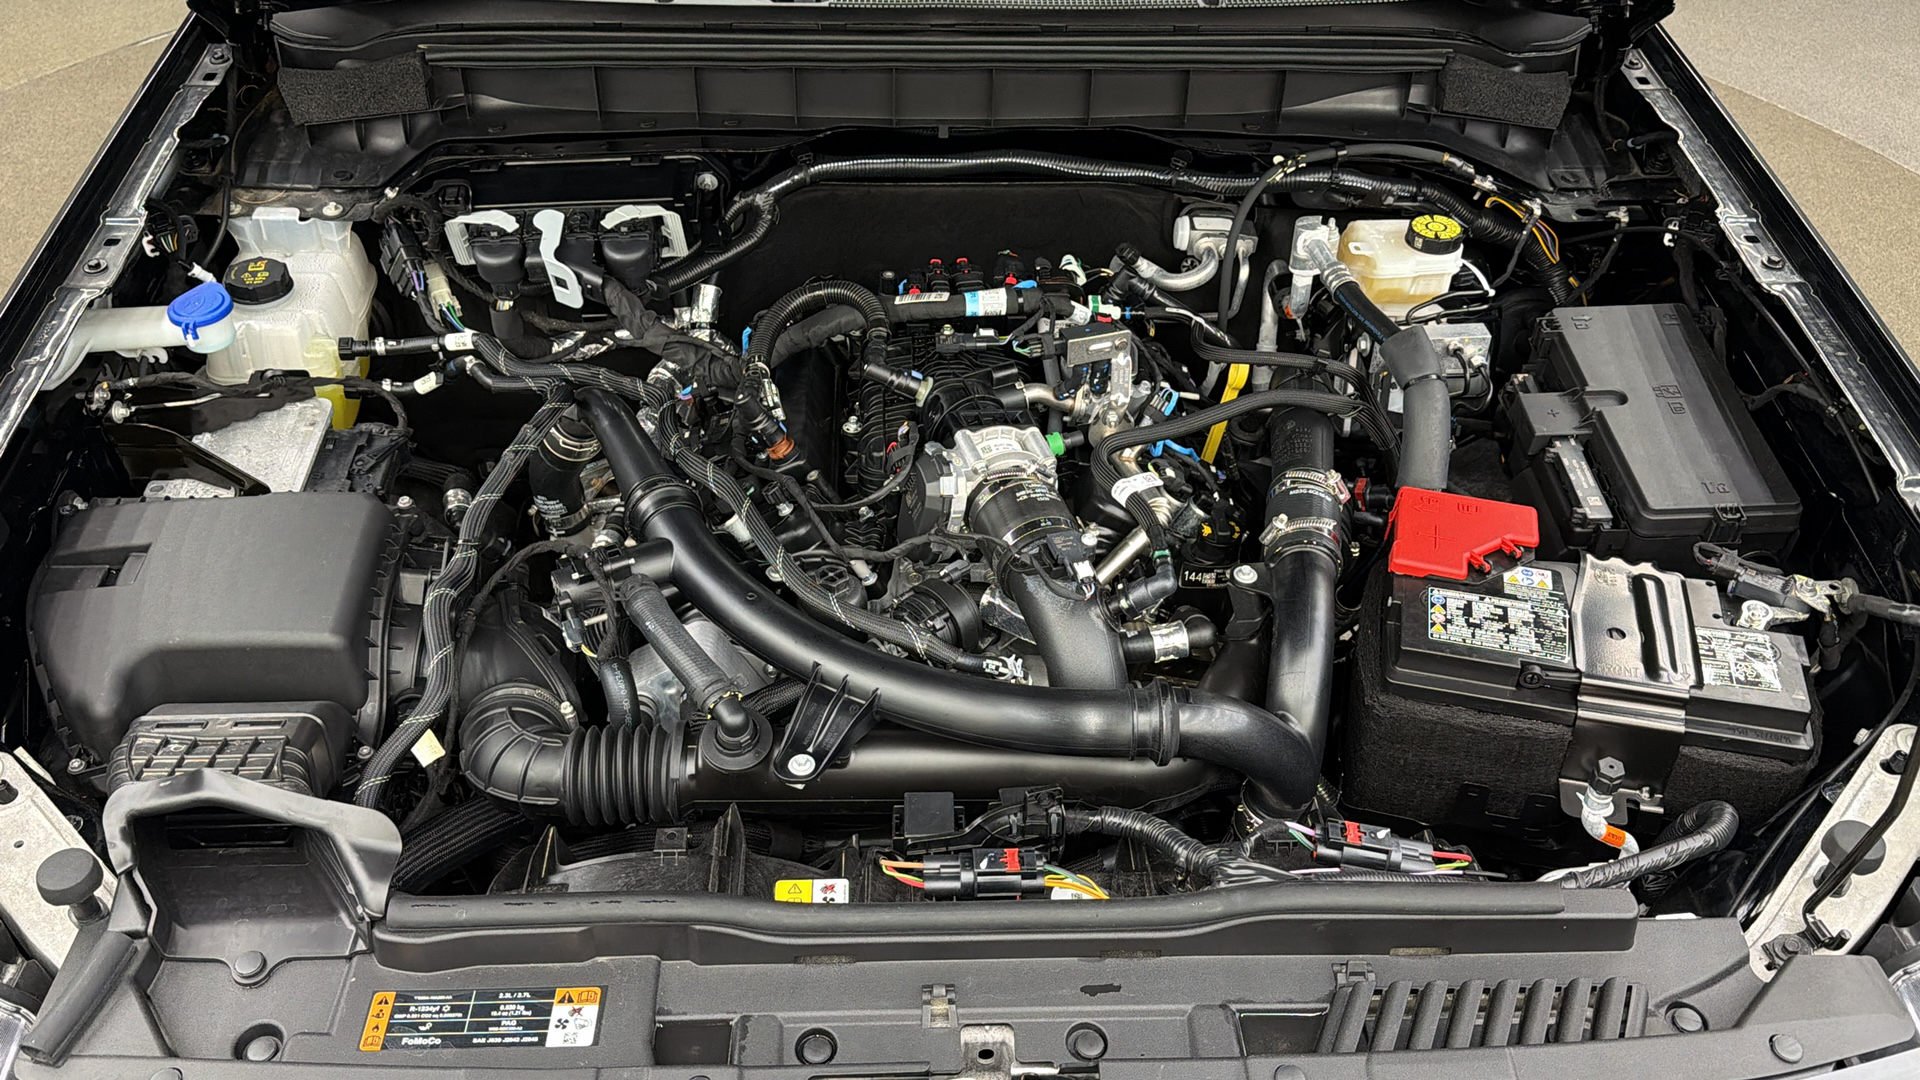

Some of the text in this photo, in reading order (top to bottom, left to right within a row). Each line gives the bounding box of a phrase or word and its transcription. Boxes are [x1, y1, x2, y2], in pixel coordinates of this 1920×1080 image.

[1184, 570, 1202, 582] 144
[1596, 661, 1640, 678] FRONT
[409, 1005, 440, 1013] R-1234yf
[401, 1036, 442, 1046] FoMoCo
